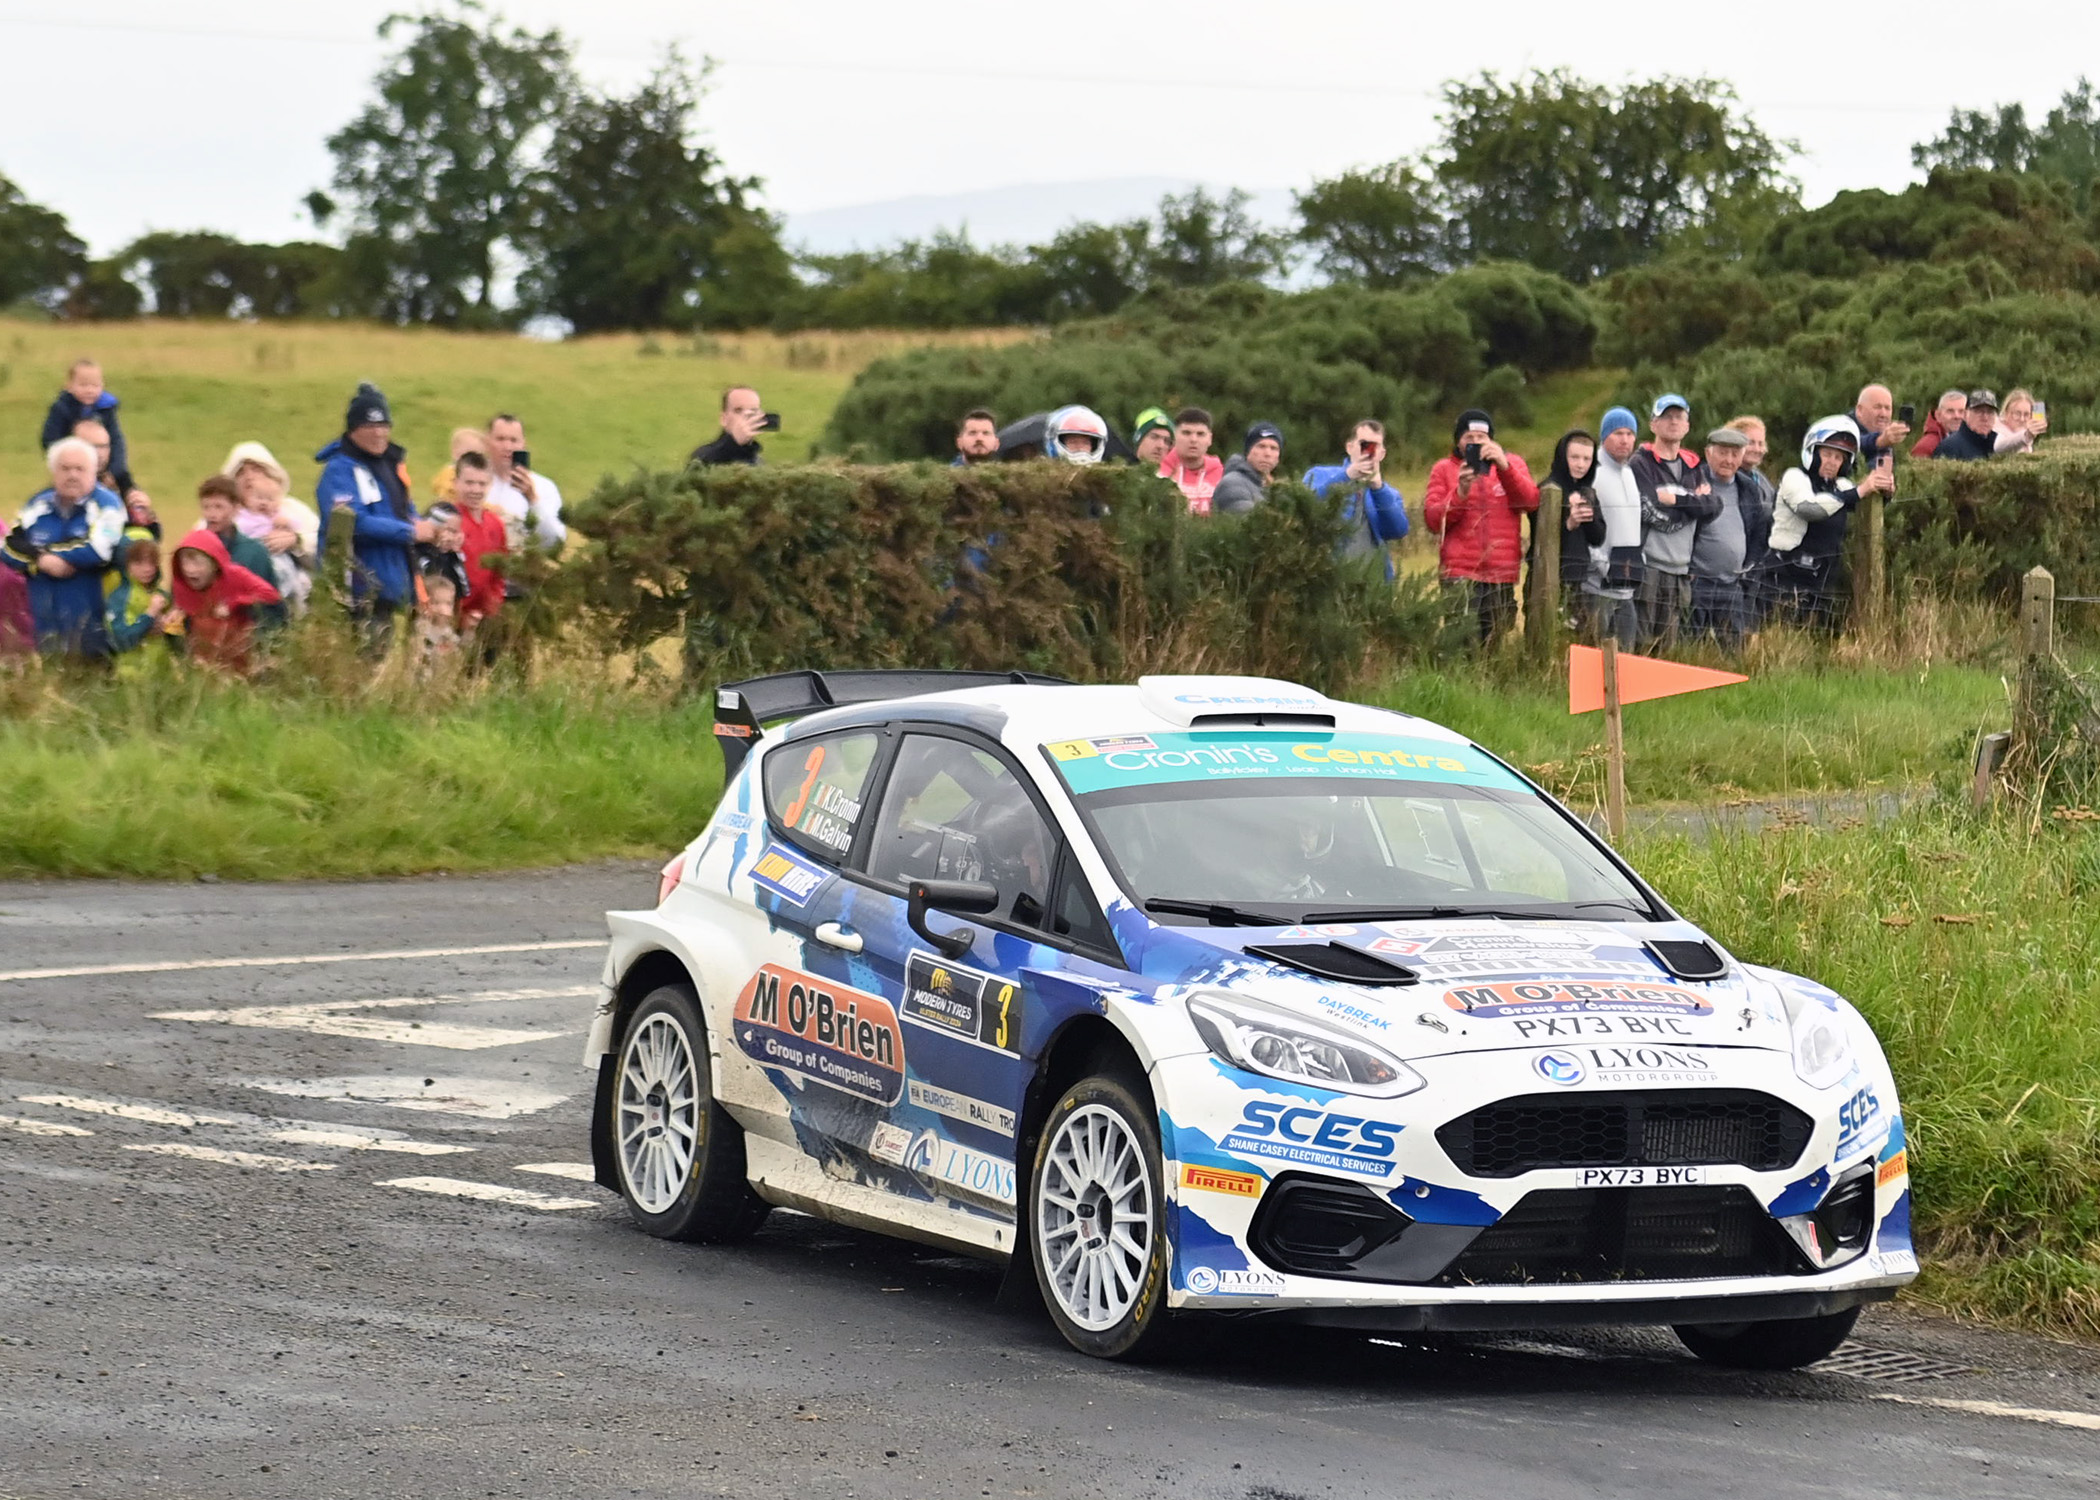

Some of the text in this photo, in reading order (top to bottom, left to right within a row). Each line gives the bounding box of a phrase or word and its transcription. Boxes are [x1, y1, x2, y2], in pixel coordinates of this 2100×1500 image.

[1065, 744, 1082, 757] 3
[1104, 744, 1467, 772] Cronin's Centra
[783, 746, 826, 828] 3
[809, 813, 853, 852] M.Galvin
[913, 989, 973, 1020] MODERN TYRES
[1453, 984, 1696, 1007] M O'Brien
[1498, 1002, 1687, 1016] Group of Companies
[750, 971, 894, 1066] M O'Brien
[996, 984, 1014, 1049] 3
[1317, 995, 1392, 1030] DAYBREAK
[1513, 1016, 1693, 1038] PX73 BYC
[766, 1038, 883, 1092] Group of Companies
[1588, 1048, 1709, 1070] LYONS
[1598, 1072, 1719, 1082] MOTORGROUP
[1232, 1100, 1407, 1157] SCES
[1839, 1087, 1880, 1142] SCES
[1228, 1138, 1387, 1174] SHANE CASEY ELECTRICAL SERVICES
[1879, 1156, 1905, 1183] PIRELLI
[944, 1149, 1015, 1199] LYONS
[1186, 1168, 1254, 1193] PIRELLI
[1583, 1167, 1698, 1185] PX73 BYC
[1221, 1271, 1286, 1285] LYONS
